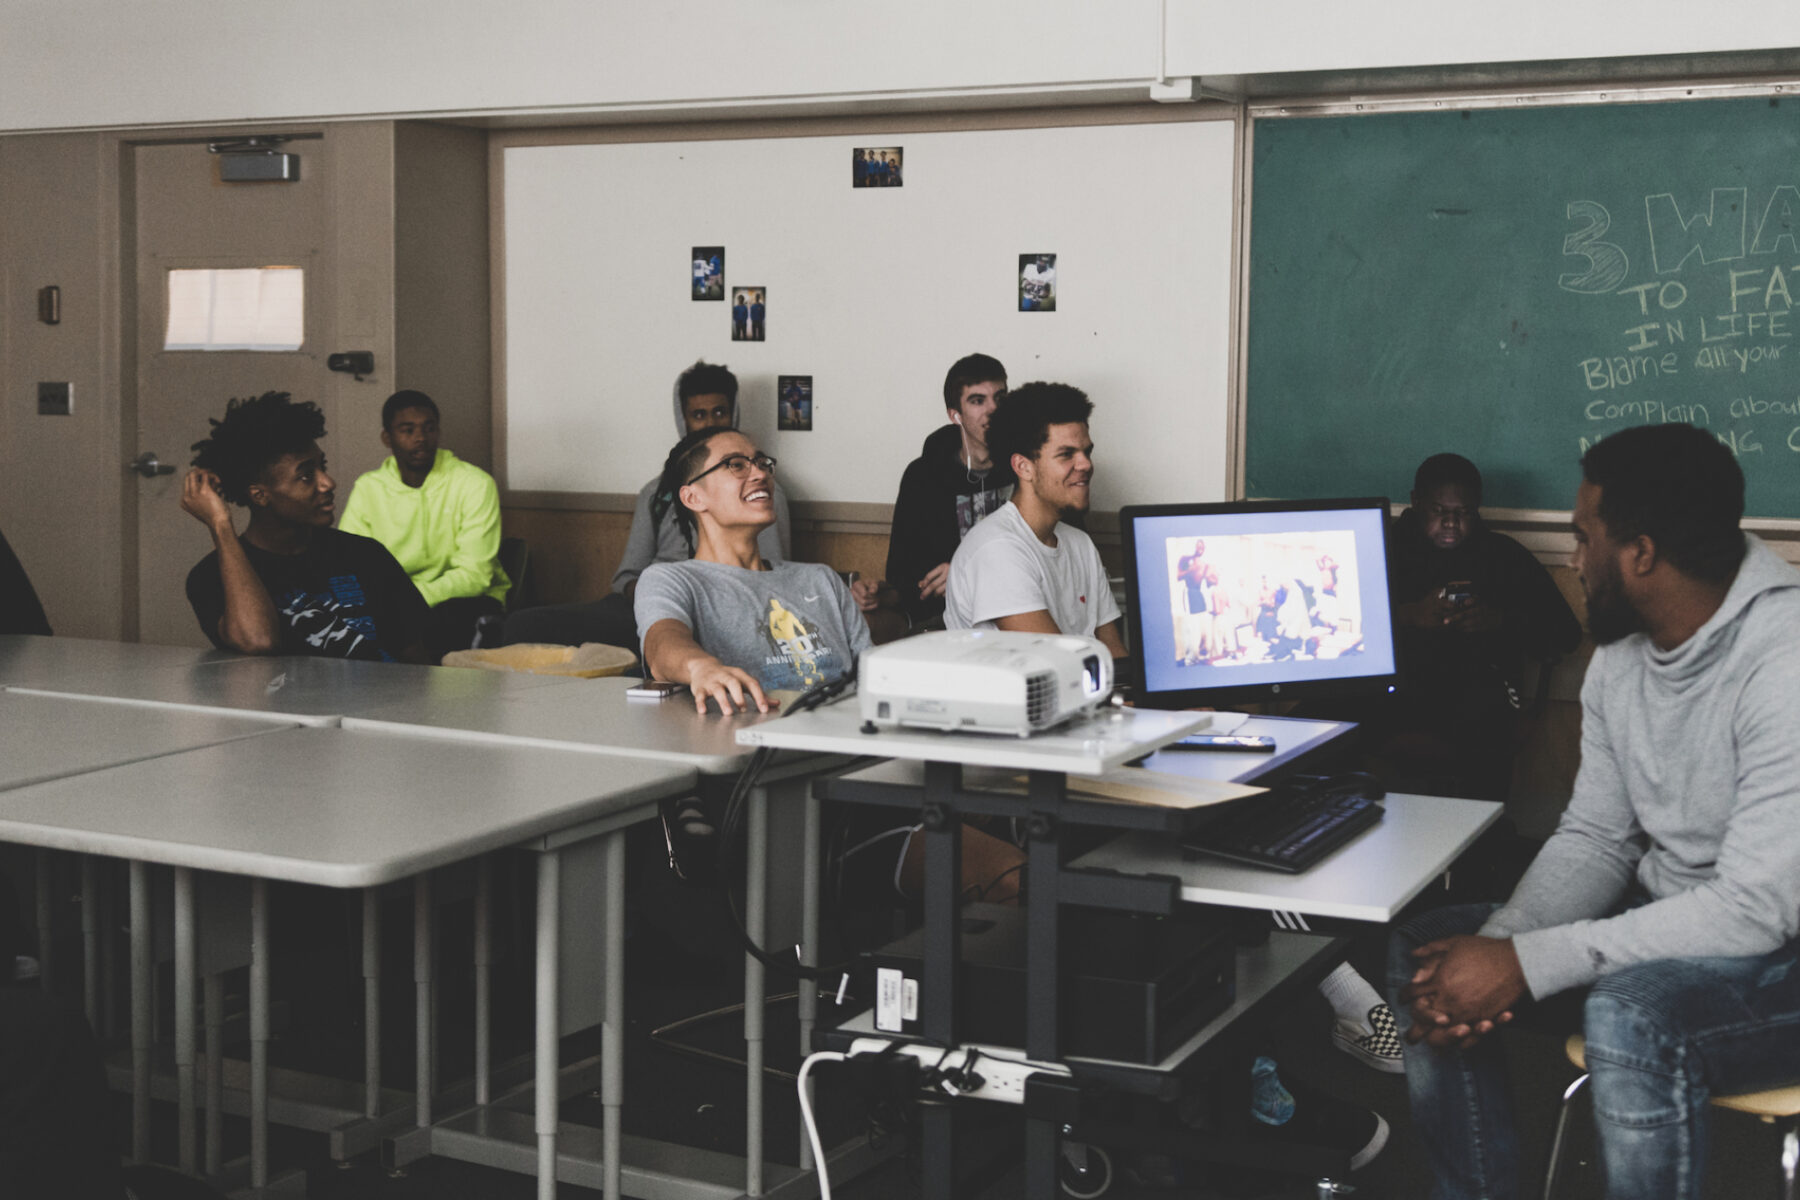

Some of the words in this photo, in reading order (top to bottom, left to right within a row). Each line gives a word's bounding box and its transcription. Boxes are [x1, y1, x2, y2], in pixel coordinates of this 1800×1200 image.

[1558, 200, 1629, 294] 3
[1617, 281, 1687, 315] TO
[1624, 320, 1686, 351] IN
[1701, 311, 1793, 342] LIFE
[1578, 352, 1679, 390] Blame
